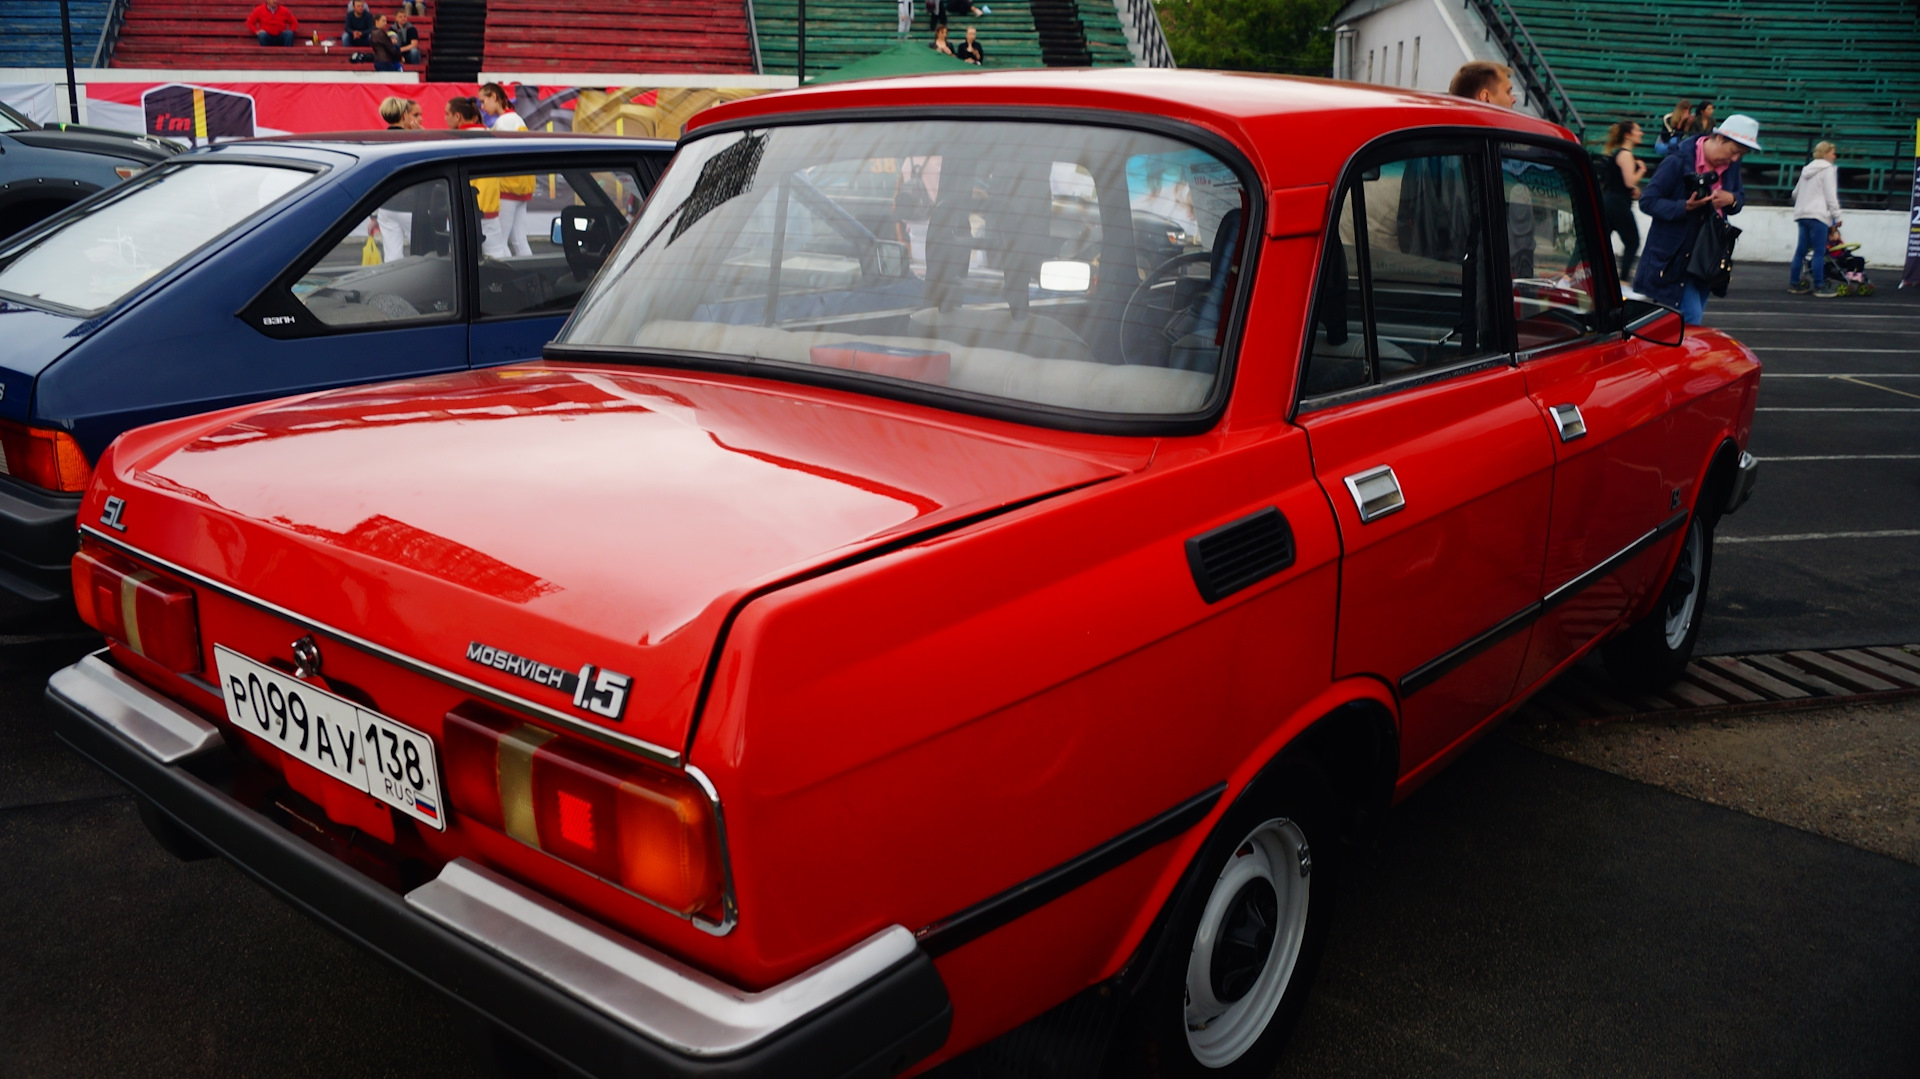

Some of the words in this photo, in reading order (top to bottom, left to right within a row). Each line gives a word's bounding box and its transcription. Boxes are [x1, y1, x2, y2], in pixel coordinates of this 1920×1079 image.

[155, 112, 191, 131] I'm
[100, 495, 127, 532] SL
[466, 641, 565, 689] MOSKVICH
[572, 663, 633, 720] 1.5
[365, 723, 425, 791] 138
[384, 777, 415, 807] RUS
